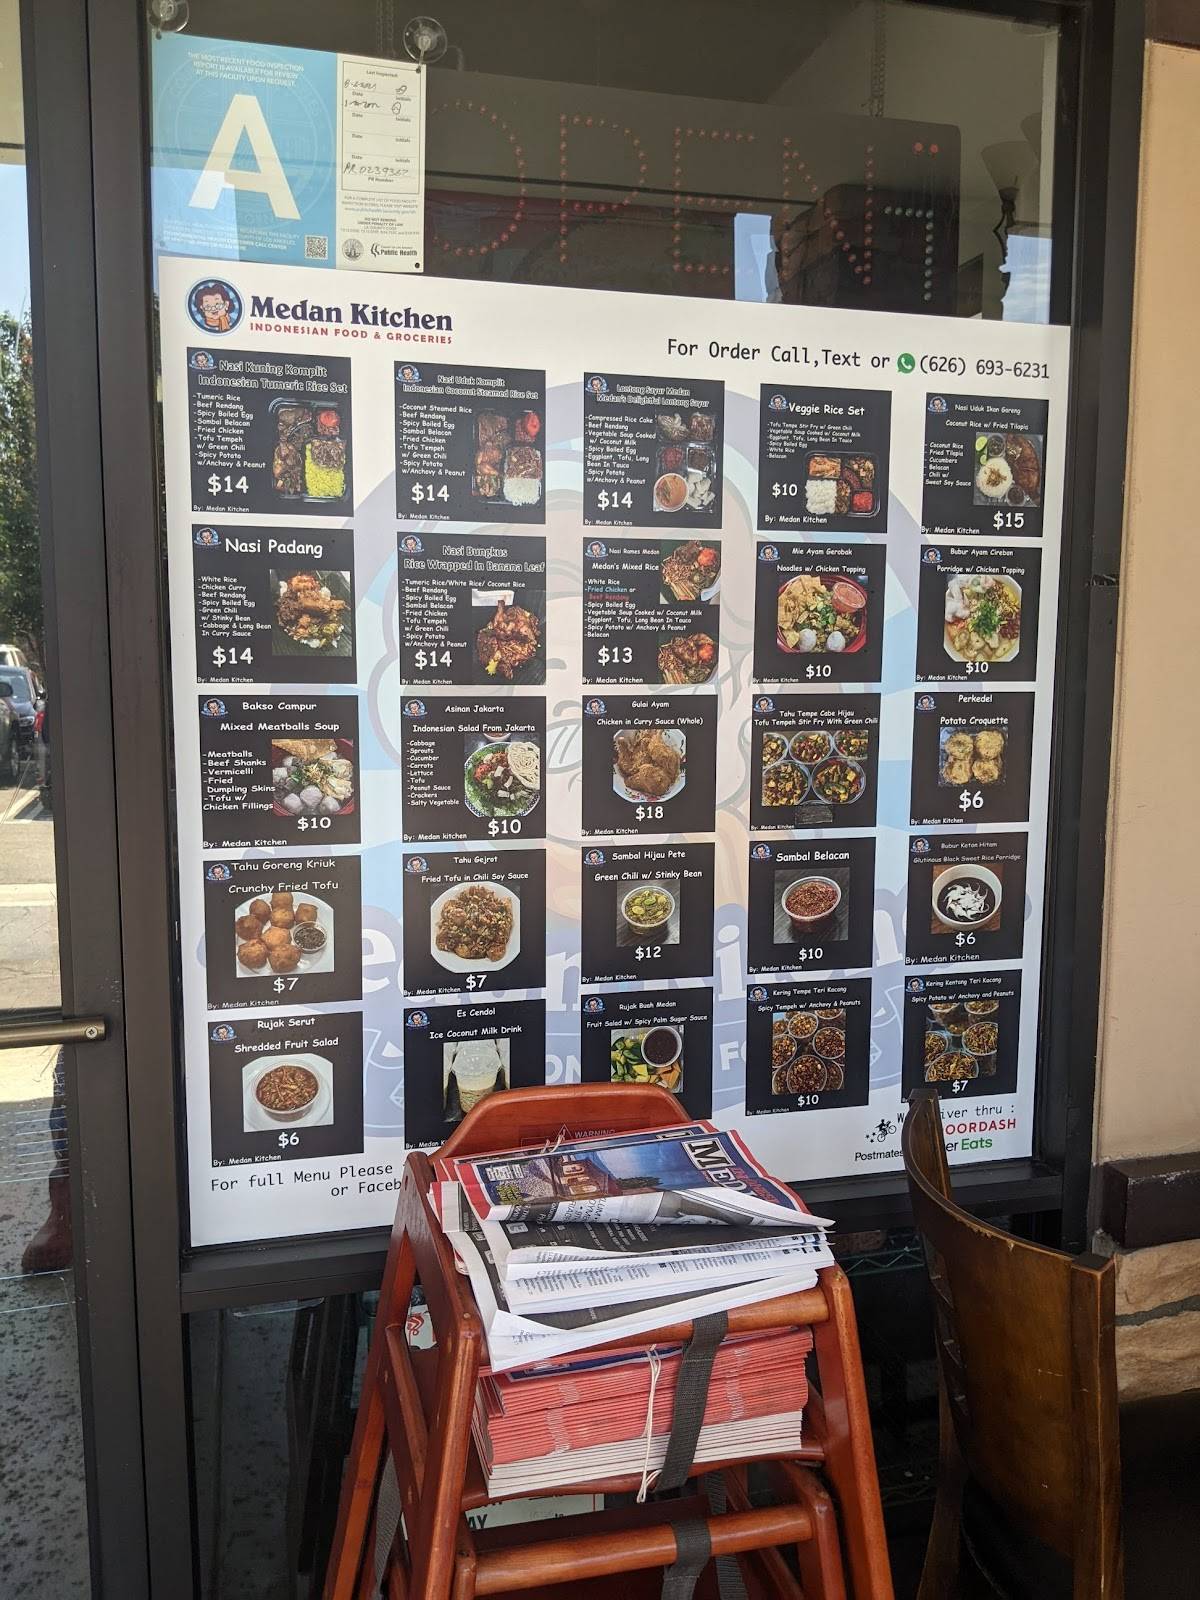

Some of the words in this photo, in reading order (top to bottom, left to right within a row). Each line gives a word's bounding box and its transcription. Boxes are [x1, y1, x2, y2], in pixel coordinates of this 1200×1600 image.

[188, 94, 301, 220] A
[251, 296, 343, 323] Medan
[350, 303, 453, 331] Kitchen
[251, 323, 328, 336] INDONESIAN
[335, 328, 368, 339] FOOD
[387, 332, 452, 344] GROCERIES
[668, 339, 698, 356] For
[709, 341, 760, 361] Order
[771, 346, 861, 368] Call,Text
[871, 355, 890, 369] or
[920, 354, 966, 375] (626)
[976, 359, 1049, 379] 693-6231
[219, 360, 243, 371] Nasi
[246, 362, 283, 376] Kuning
[285, 364, 327, 377] Komplit
[199, 375, 258, 388] Indonesian
[260, 379, 303, 390] Tumeric
[306, 381, 327, 392] Rice
[330, 383, 347, 393] Set
[788, 402, 819, 415] Veggie
[824, 404, 843, 414] Rice
[848, 406, 864, 416] Set
[208, 474, 248, 495] $14
[772, 482, 798, 498] $10
[412, 482, 449, 504] $14
[598, 489, 632, 510] $14
[993, 511, 1024, 530] $15
[225, 539, 261, 552] Nasi
[269, 540, 322, 558] Padang
[443, 545, 464, 556] Nasi
[467, 546, 508, 558] Bungkus
[404, 559, 425, 569] Rice
[427, 560, 472, 571] Wrapped
[475, 561, 484, 570] In
[487, 562, 522, 571] Banana
[525, 562, 545, 572] Leaf
[842, 566, 866, 574] Topping
[213, 646, 253, 667] $14
[415, 649, 452, 670] $14
[598, 645, 632, 666] $13
[806, 664, 831, 679] $10
[966, 662, 988, 674] $10
[958, 695, 992, 703] Perkedel
[243, 702, 273, 710] Bakso
[278, 703, 316, 712] Campur
[473, 705, 504, 713] Jakarta
[220, 723, 253, 731] Mixed
[258, 723, 309, 731] Meatballs
[315, 723, 339, 732] Soup
[677, 717, 703, 725] (Whole)
[940, 717, 966, 725] Potato
[970, 717, 1008, 725] Croquette
[208, 786, 247, 794] Dumpling
[959, 790, 983, 812] $6
[635, 805, 663, 821] $18
[298, 817, 331, 831] $10
[488, 818, 521, 837] $10
[474, 856, 497, 864] Gejrot
[644, 853, 665, 861] Hijau
[776, 852, 810, 862] Sambal
[815, 851, 849, 860] Belacan
[231, 863, 258, 871] Tahu
[263, 862, 302, 870] Goreng
[307, 860, 335, 869] Kriuk
[655, 871, 680, 879] Stinky
[229, 884, 274, 893] Crunchy
[279, 882, 308, 891] Fried
[312, 881, 338, 889] Tofu
[955, 932, 976, 947] $6
[635, 946, 661, 961] $12
[799, 948, 823, 961] $10
[273, 977, 298, 993] $7
[466, 974, 487, 990] $7
[470, 1008, 495, 1016] Cendol
[258, 1020, 284, 1029] Rujak
[289, 1018, 315, 1026] Serut
[501, 1026, 522, 1034] Drink
[235, 1042, 280, 1053] Shredded
[285, 1040, 308, 1048] Fruit
[313, 1038, 338, 1047] Salad
[952, 1080, 968, 1093] $7
[798, 1095, 819, 1107] $10
[897, 1112, 906, 1123] W
[940, 1109, 967, 1119] iver
[945, 1119, 1016, 1135] OORDASH
[278, 1132, 299, 1148] $6
[945, 1142, 958, 1151] er
[854, 1151, 903, 1162] Postmates
[211, 1179, 237, 1191] For
[250, 1173, 283, 1187] full
[294, 1170, 330, 1183] Menu
[341, 1164, 392, 1178] Please
[331, 1185, 348, 1196] or
[359, 1179, 401, 1193] Faceb
